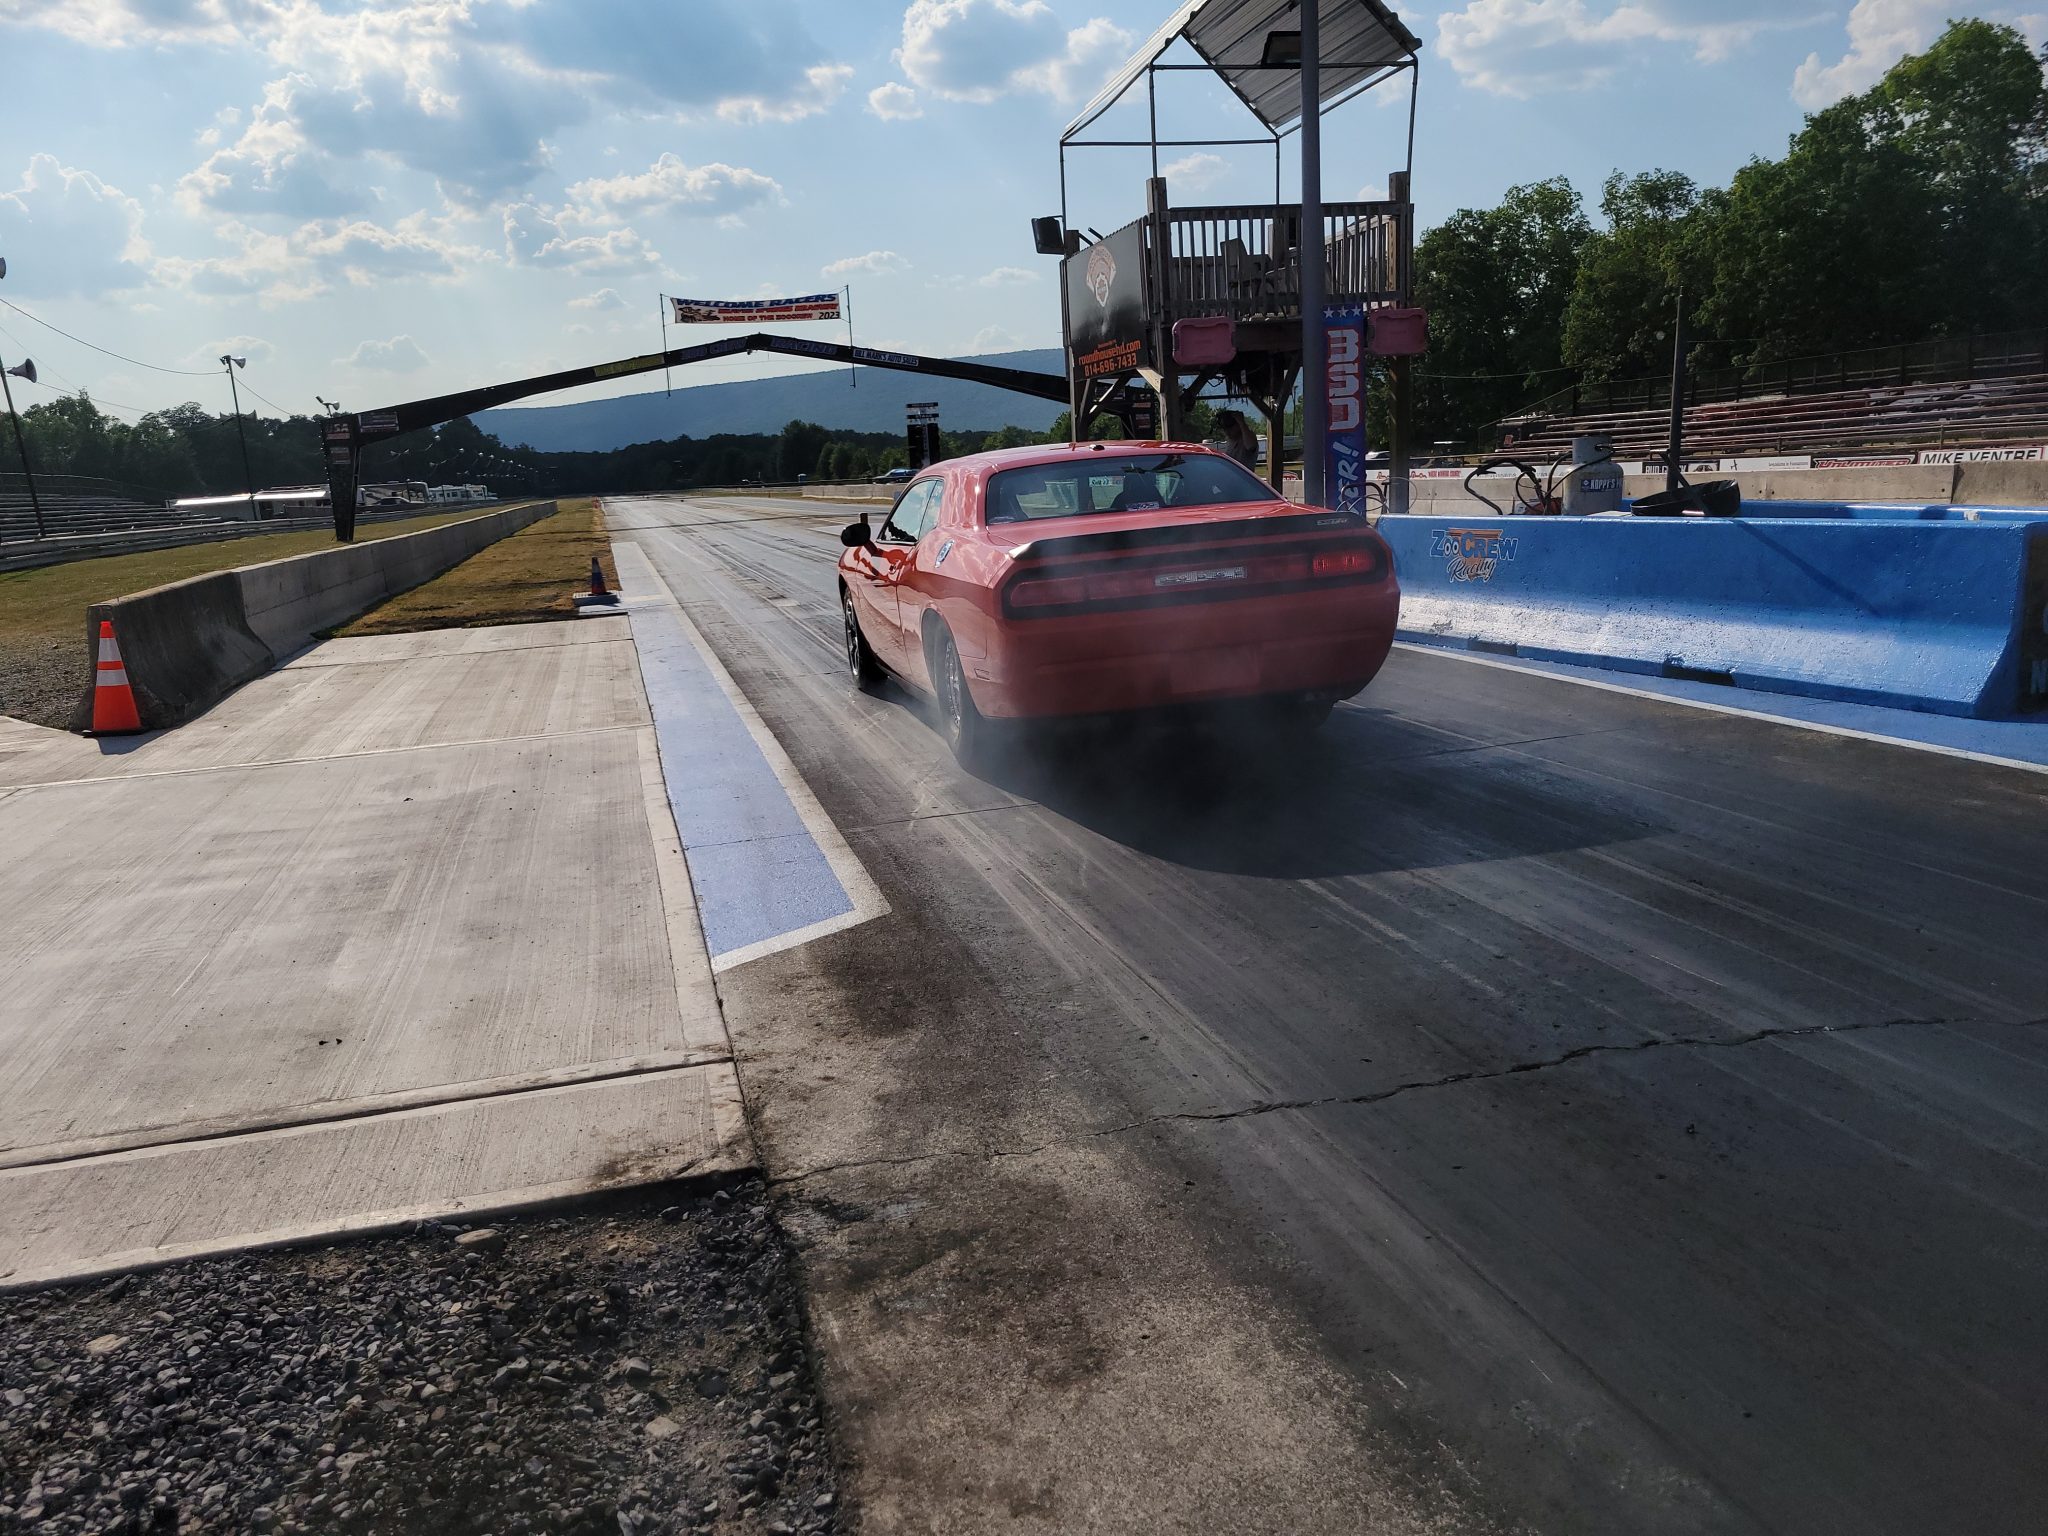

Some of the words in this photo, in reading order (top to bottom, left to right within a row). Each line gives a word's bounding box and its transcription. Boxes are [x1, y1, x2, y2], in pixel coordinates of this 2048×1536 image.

[676, 299, 764, 308] WELCOME
[767, 293, 837, 307] RACERS
[818, 311, 840, 320] 2023
[1079, 340, 1141, 366] roundhousehd.com
[1084, 352, 1137, 377] 814-696-7433
[1924, 451, 1963, 465] MIKE
[1969, 449, 2039, 461] VENTRE
[1447, 557, 1497, 583] Racing
